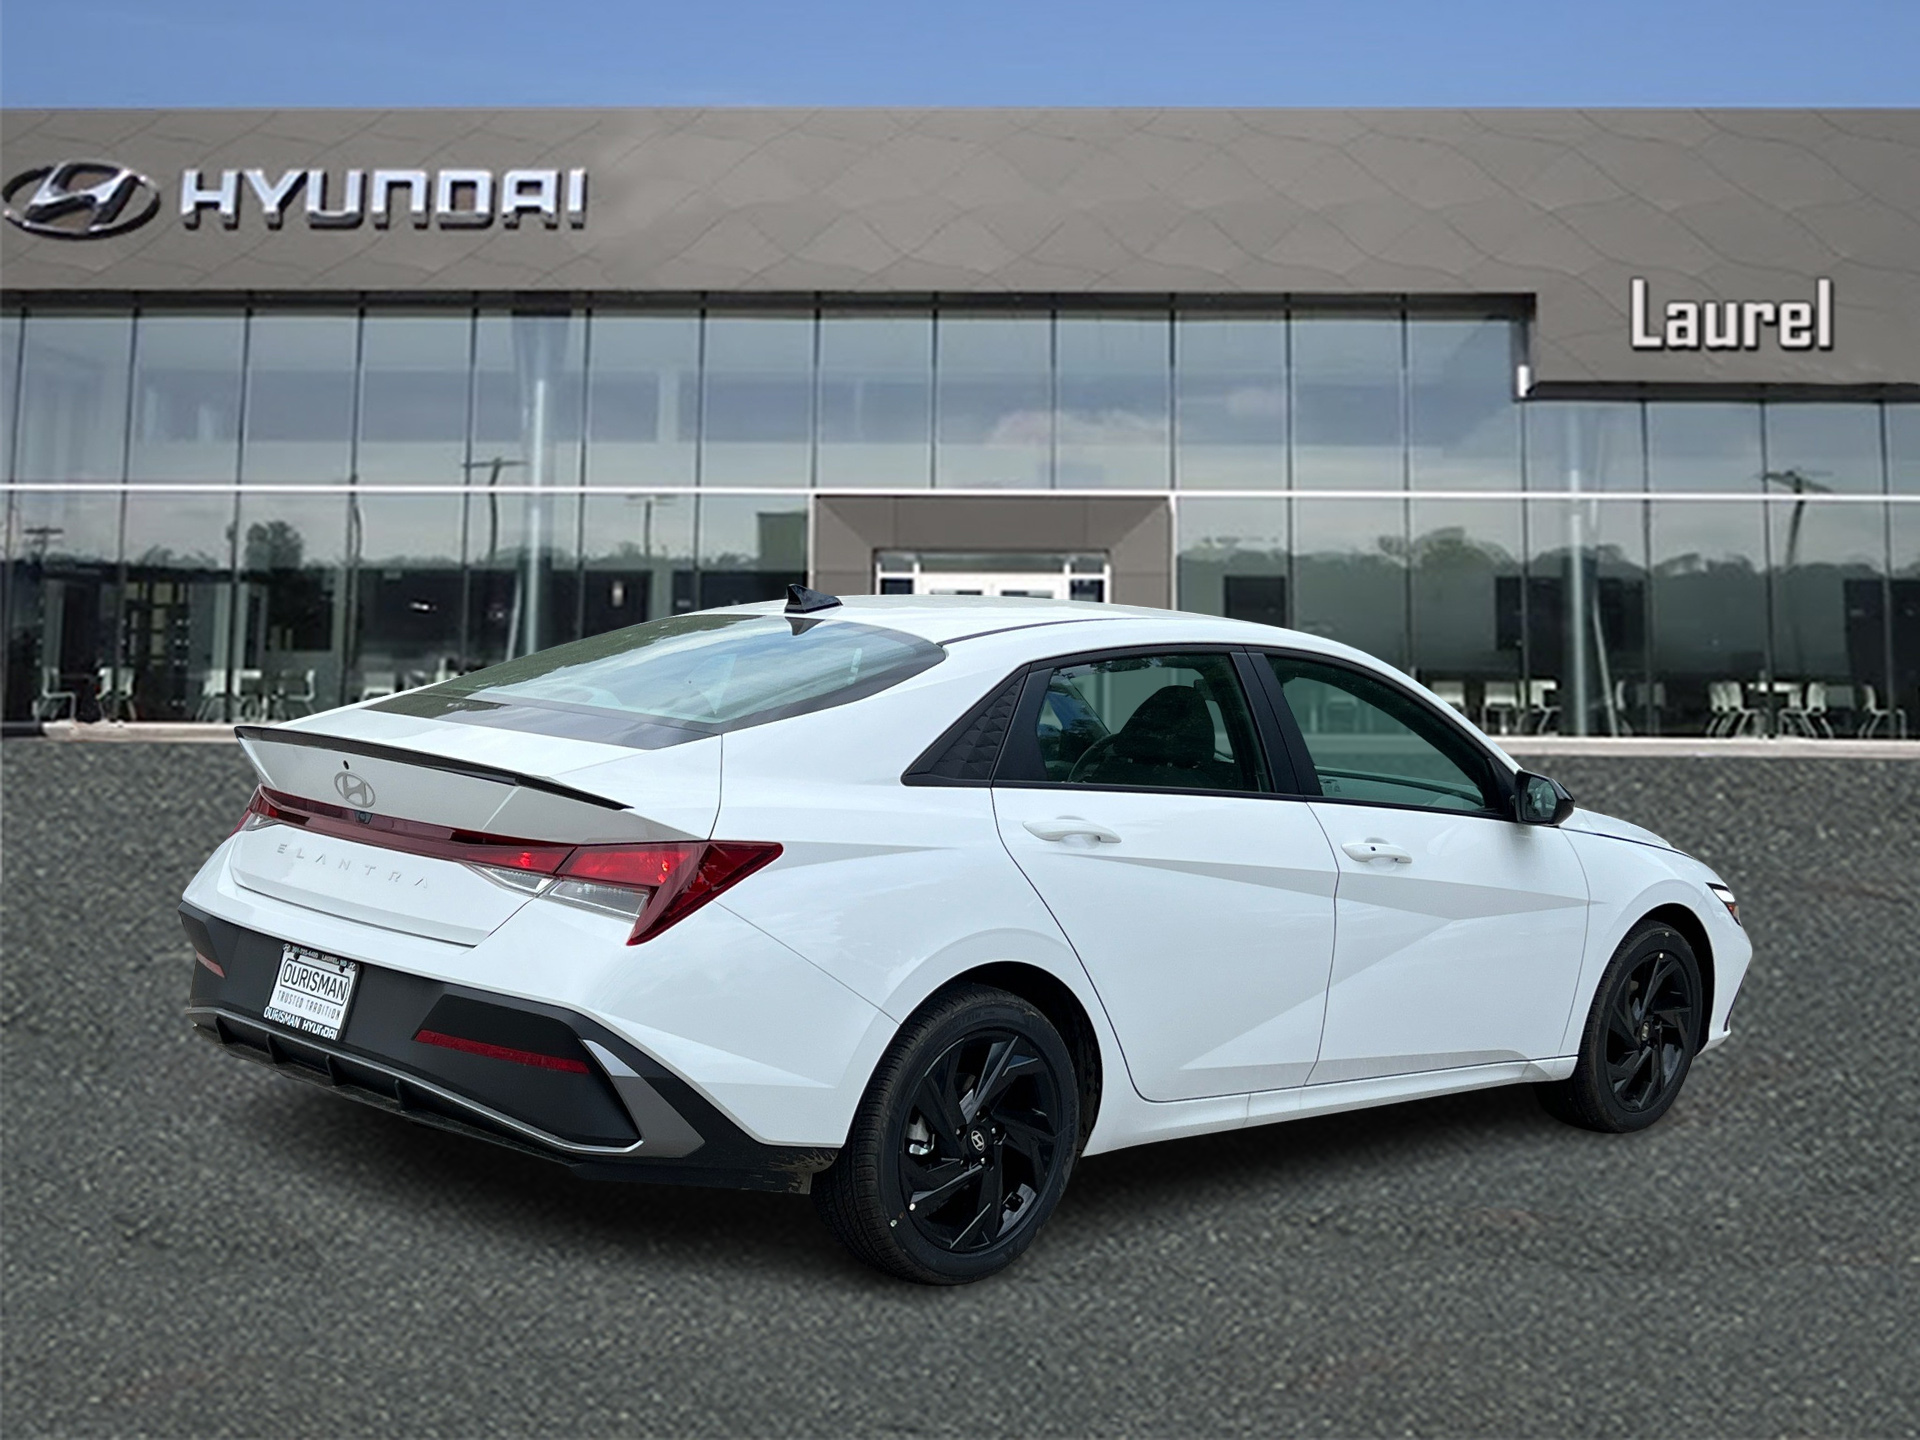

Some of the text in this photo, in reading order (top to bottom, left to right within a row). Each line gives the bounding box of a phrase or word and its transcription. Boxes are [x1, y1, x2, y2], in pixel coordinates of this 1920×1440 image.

[179, 169, 588, 230] HYUNDAI
[1631, 278, 1832, 348] Laurel
[277, 844, 428, 889] ELANTRA
[283, 963, 348, 1001] OURISMAN
[263, 1006, 338, 1040] OURISMAN HYUNDAI
[277, 990, 342, 1020] TRUSTED TRADITION
